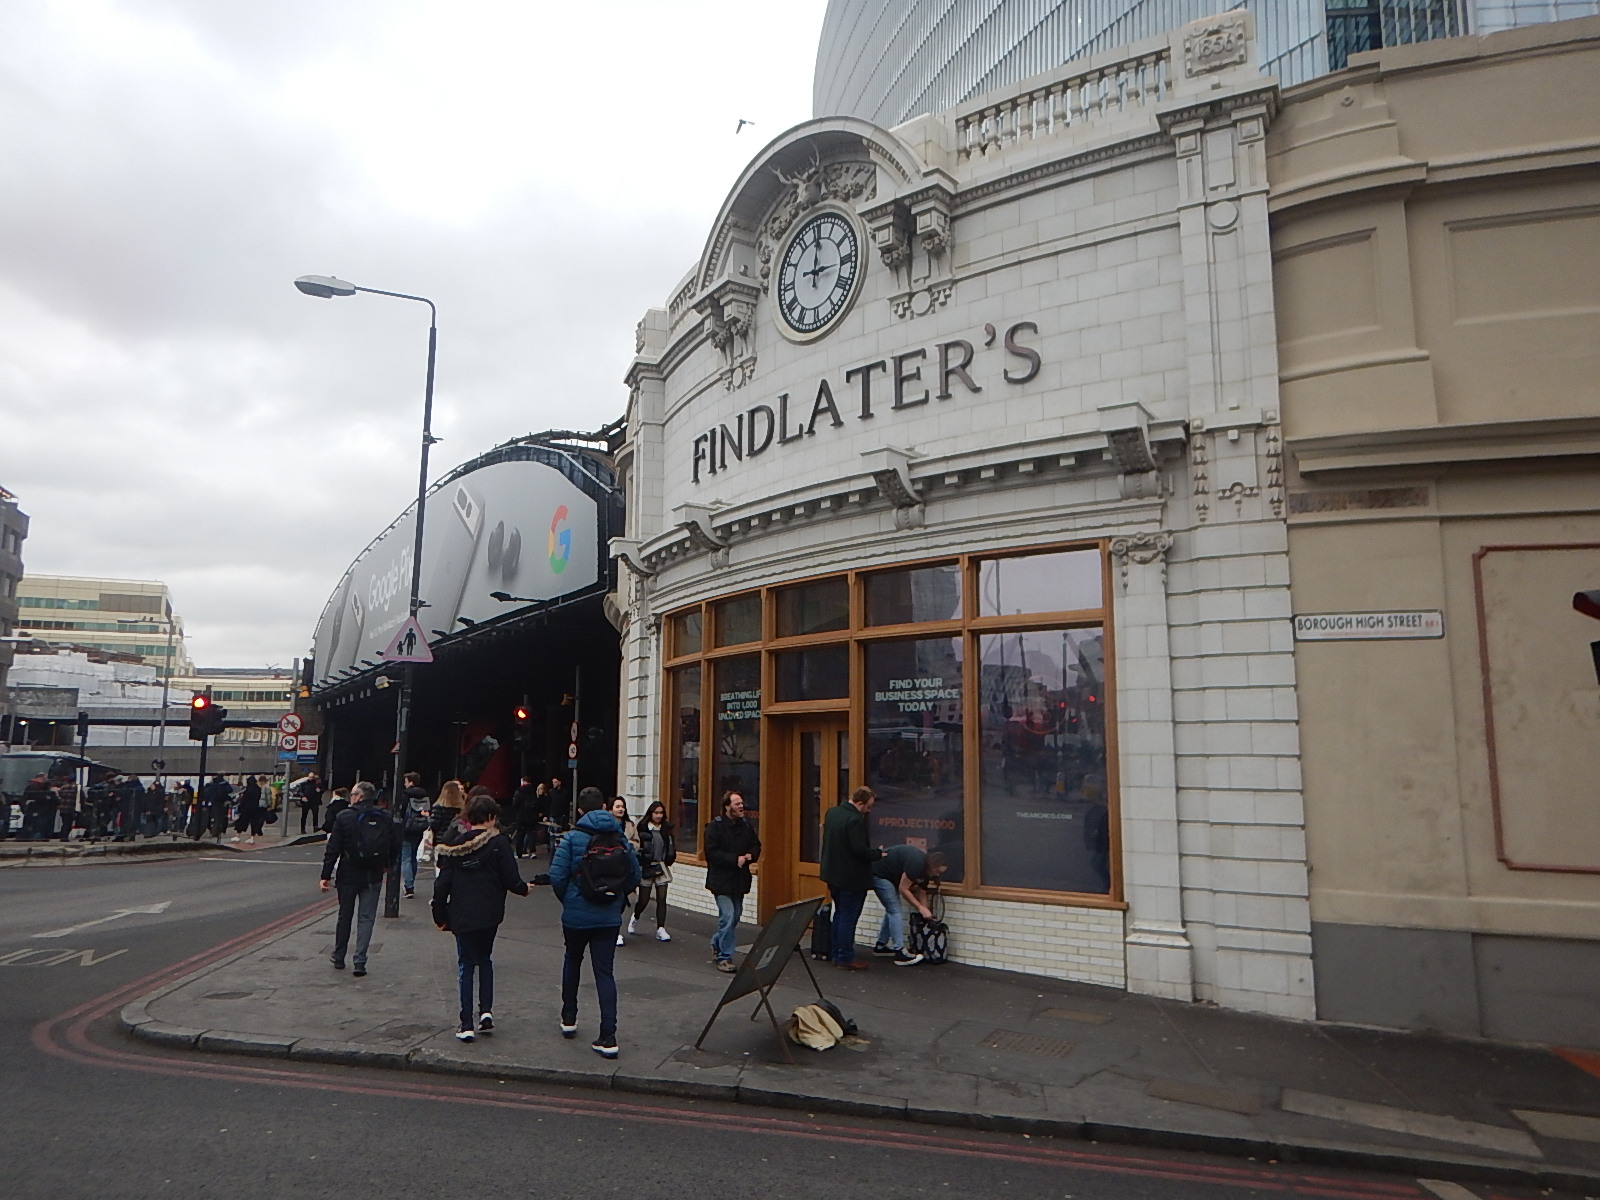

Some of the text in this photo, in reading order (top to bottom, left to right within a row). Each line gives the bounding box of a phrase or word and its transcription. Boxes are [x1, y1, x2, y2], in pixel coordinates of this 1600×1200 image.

[691, 321, 1042, 484] FINDLATER'S
[368, 558, 399, 612] Google
[1297, 616, 1353, 631] BOROUGH
[1356, 615, 1385, 629] HIGH
[1387, 614, 1423, 628] STREET
[889, 677, 943, 690] FIND YOUR
[753, 689, 762, 699] LIF
[875, 688, 960, 702] BUSINESS SPACE
[898, 701, 935, 712] TODAY
[744, 709, 762, 719] SPAC
[878, 817, 956, 830] #PROJECT1000
